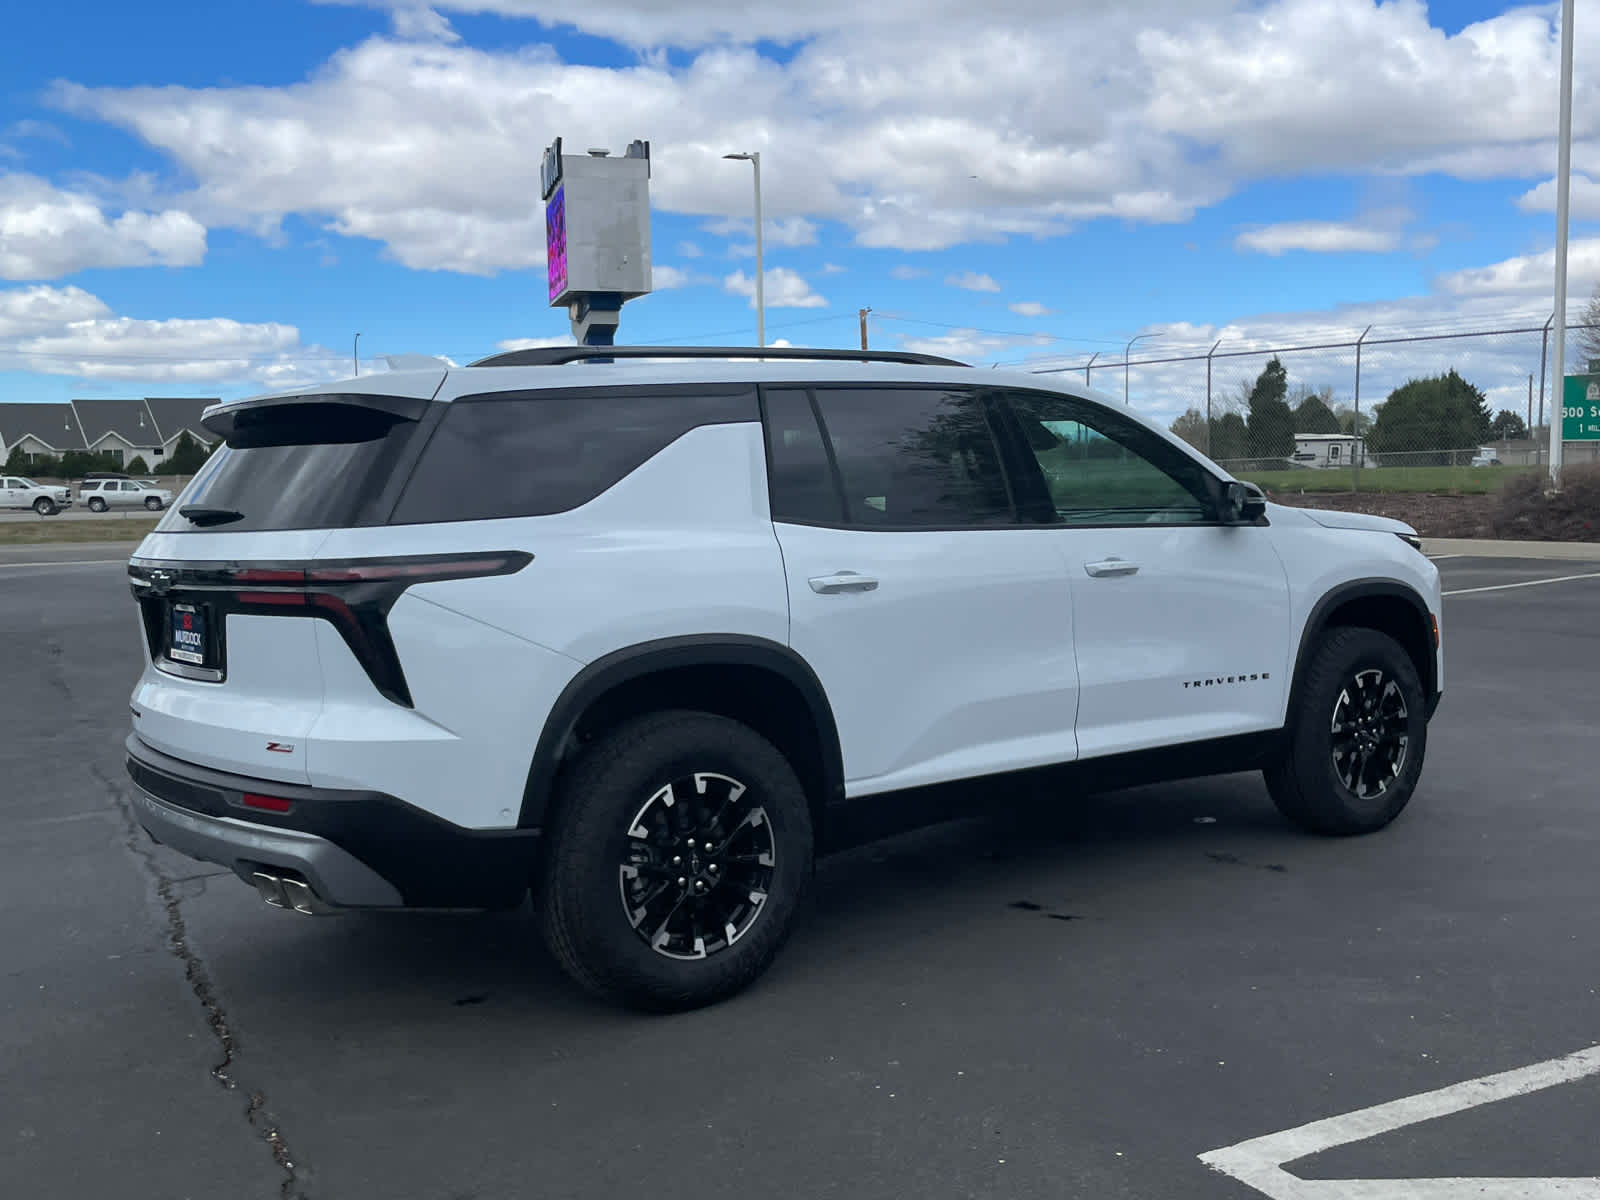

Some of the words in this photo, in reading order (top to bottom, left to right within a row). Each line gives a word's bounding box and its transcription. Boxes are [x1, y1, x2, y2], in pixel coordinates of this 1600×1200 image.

[1591, 406, 1600, 417] S
[175, 629, 202, 646] MURDOCK
[1183, 673, 1270, 688] TRAVERSE
